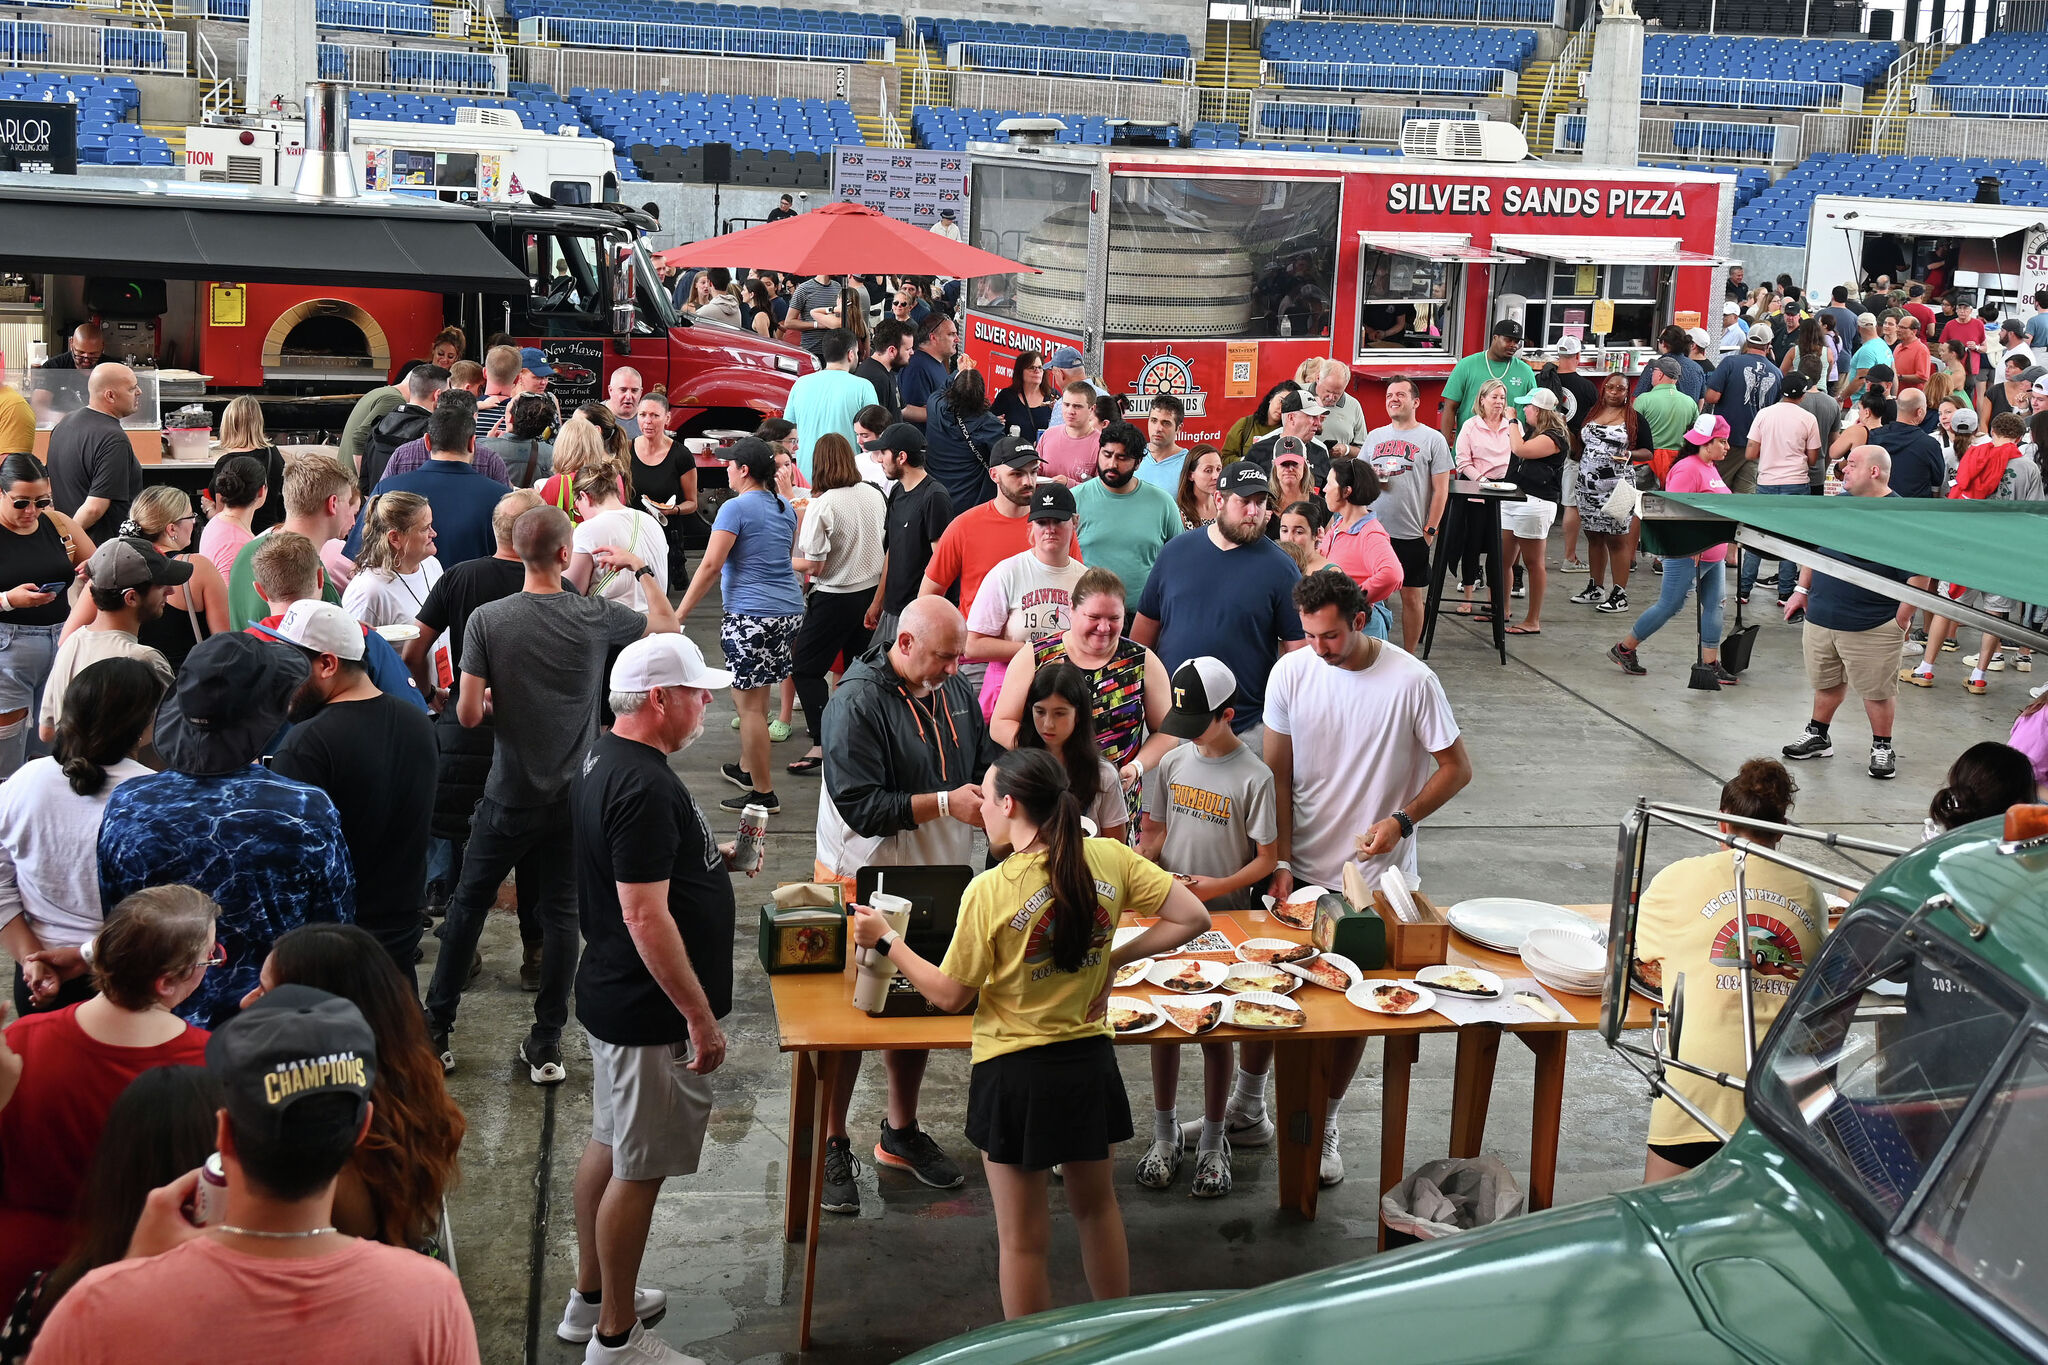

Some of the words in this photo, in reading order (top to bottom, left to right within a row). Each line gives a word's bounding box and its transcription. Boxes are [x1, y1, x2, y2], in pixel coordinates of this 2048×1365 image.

[0, 118, 51, 143] ARLOR
[15, 144, 35, 152] ROLLING
[36, 144, 50, 152] JOINT
[186, 150, 213, 166] TION
[842, 157, 864, 165] FOX
[891, 160, 912, 168] FOX
[940, 162, 961, 170] FOX
[866, 174, 888, 182] FOX
[915, 177, 936, 185] FOX
[840, 188, 862, 196] FOX
[889, 191, 911, 199] FOX
[939, 193, 960, 201] FOX
[1387, 182, 1492, 213] SILVER
[1502, 184, 1600, 216] SANDS
[1607, 188, 1686, 217] PIZZA
[914, 207, 935, 215] FOX
[974, 321, 1007, 347] SILVER
[1008, 330, 1042, 353] SANDS
[1044, 339, 1071, 359] PIZ
[543, 342, 567, 358] New
[568, 341, 602, 358] Haven
[571, 386, 591, 395] Truck
[1129, 398, 1151, 412] SILV
[1174, 430, 1221, 442] llingford
[1371, 439, 1420, 462] RBNY
[1237, 469, 1268, 482] Title
[1021, 587, 1069, 611] SHAWNEE
[1024, 613, 1037, 628] 19
[1174, 686, 1186, 708] T
[1170, 783, 1231, 819] TRUMBULL
[1206, 814, 1228, 827] STARS
[1008, 908, 1032, 932] BIG
[1093, 879, 1117, 902] IZZA
[1701, 898, 1722, 919] BIG
[1718, 887, 1757, 907] GRN
[1756, 889, 1788, 908] PIZZA
[1788, 898, 1816, 933] TRUCK
[1716, 974, 1794, 996] 203-2-9547
[276, 1050, 355, 1072] NATIONAL
[264, 1057, 367, 1105] CHAMPIONS
